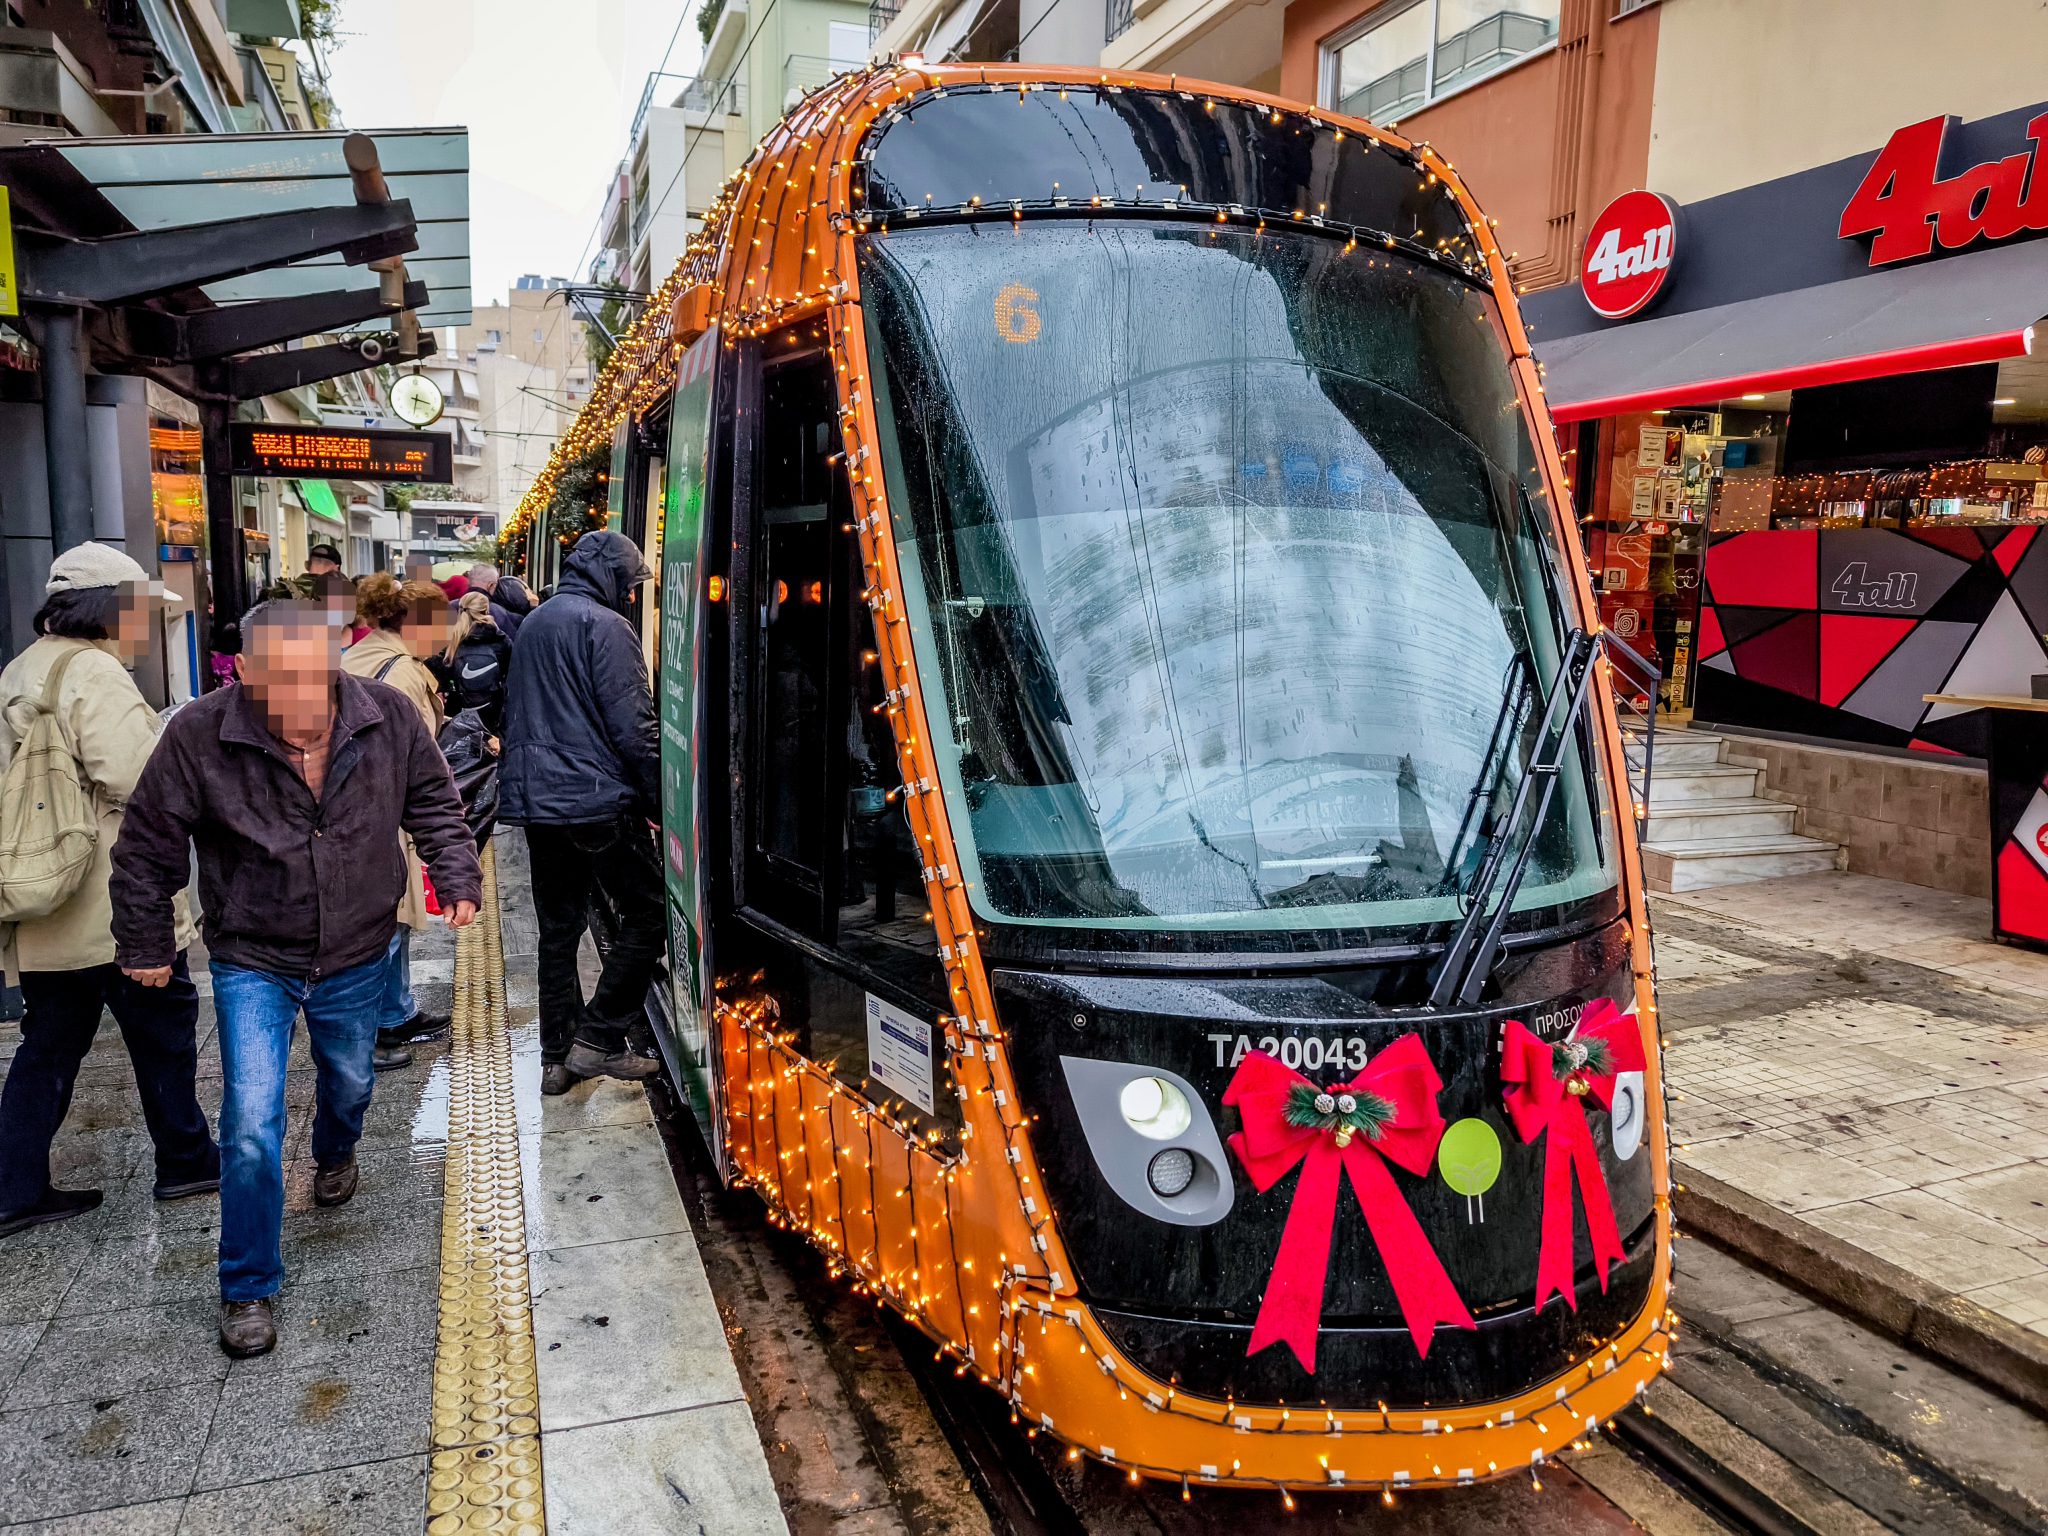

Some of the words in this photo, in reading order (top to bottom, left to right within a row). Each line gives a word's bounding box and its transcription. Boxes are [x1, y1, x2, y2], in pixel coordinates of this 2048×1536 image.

[1587, 224, 1672, 284] 4all
[995, 283, 1041, 343] 6
[1832, 562, 1917, 608] 4all
[1535, 1001, 1592, 1035] ΠΡΟΣΟΧ
[1207, 1033, 1368, 1071] TA20043
